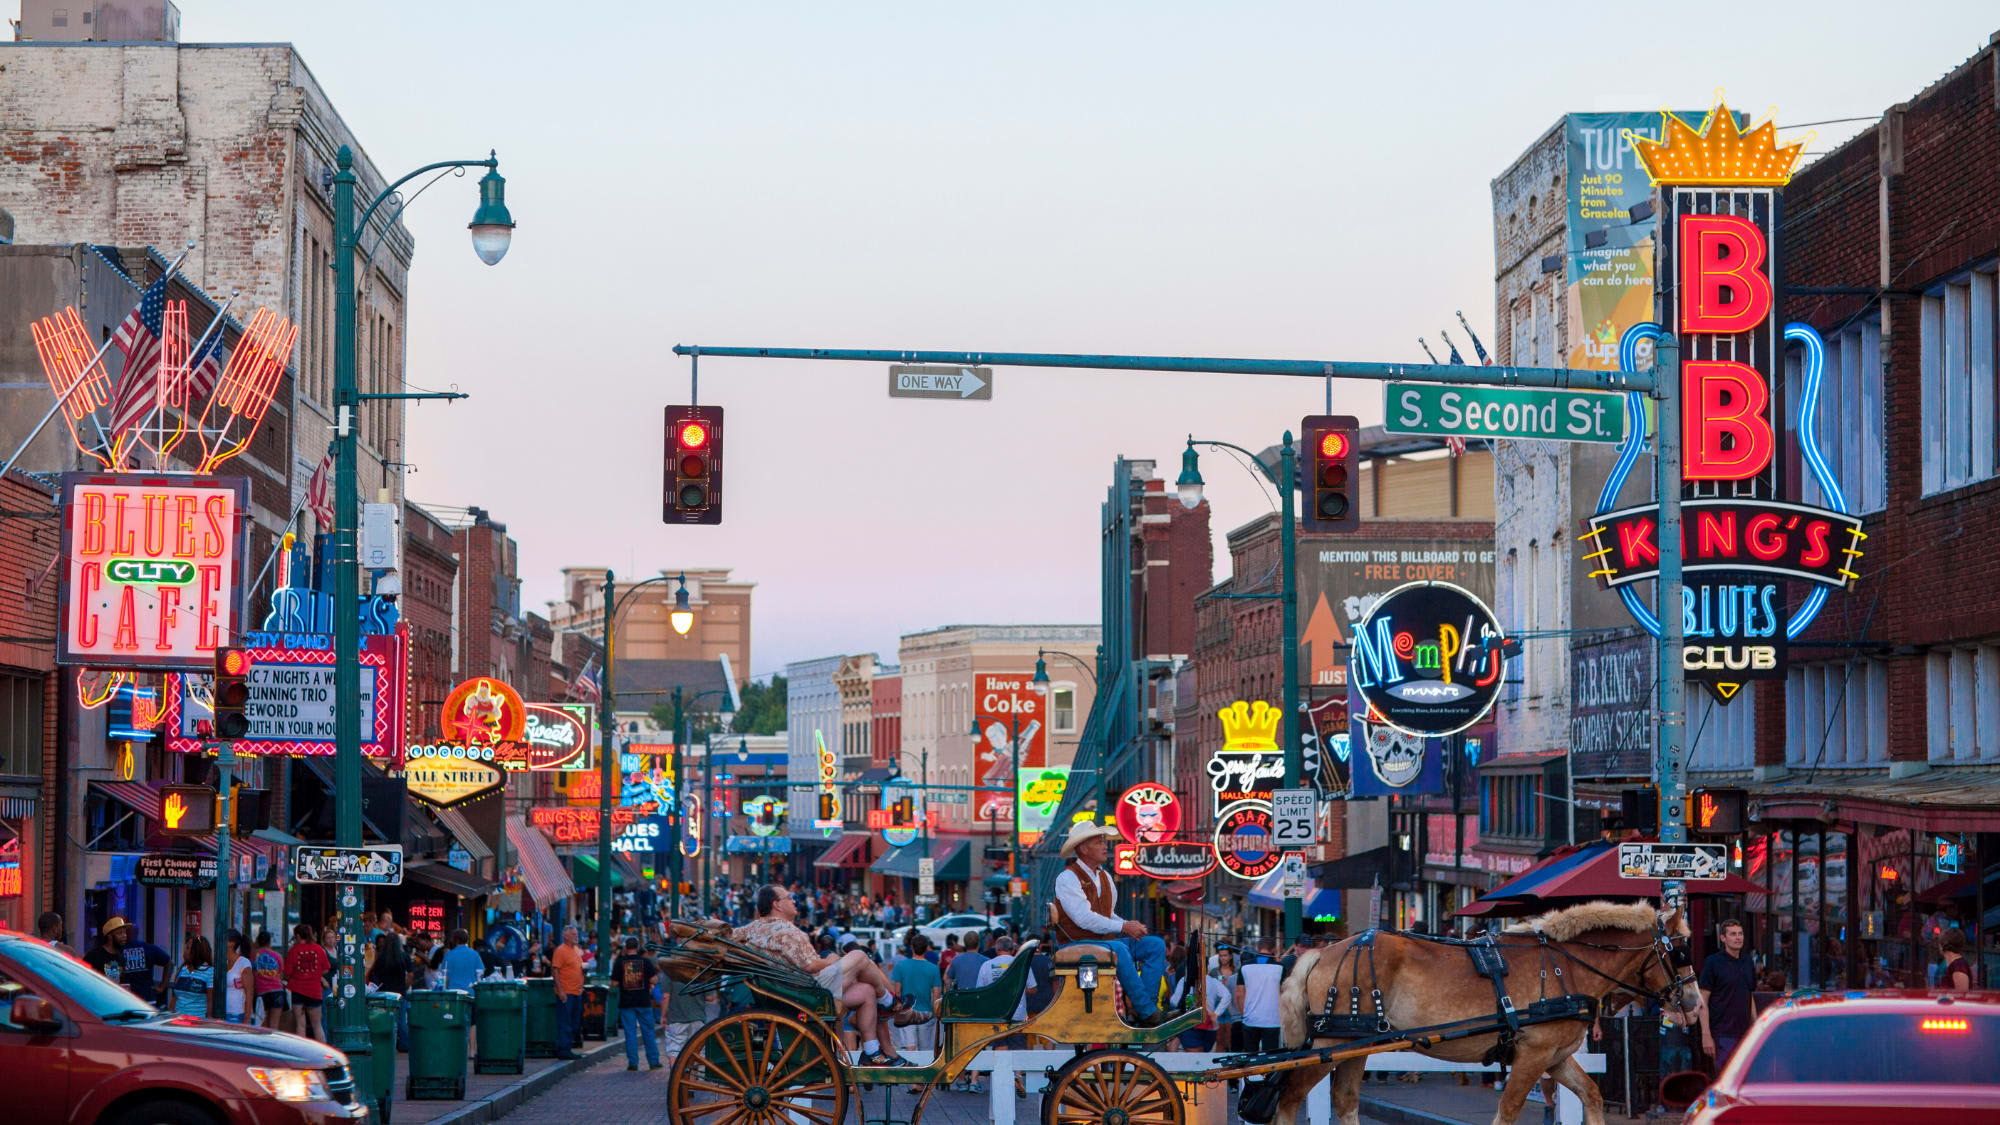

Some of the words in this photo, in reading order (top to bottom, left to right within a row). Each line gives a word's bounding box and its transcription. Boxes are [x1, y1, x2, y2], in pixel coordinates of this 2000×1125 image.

[1580, 127, 1657, 170] TUPE
[1580, 174, 1602, 185] Just
[1605, 174, 1623, 185] 90
[1580, 186, 1624, 196] Minutes
[1580, 197, 1606, 208] from
[1582, 247, 1631, 260] imagine
[1583, 261, 1612, 272] what
[1615, 263, 1637, 275] you
[1680, 214, 1773, 334] B
[1583, 277, 1608, 286] can
[1610, 275, 1623, 286] do
[1625, 275, 1652, 286] here
[1582, 334, 1651, 366] tupo
[901, 375, 929, 389] ONE
[934, 376, 963, 390] WAY
[1399, 390, 1429, 428] S.
[1438, 391, 1557, 434] Second
[1565, 398, 1612, 437] St.
[1681, 359, 1774, 481] B
[80, 492, 227, 559] BLUES
[1616, 511, 1832, 569] KNG'S
[1319, 551, 1369, 563] MENTION
[1372, 551, 1398, 563] THIS
[1401, 551, 1459, 563] BILLBOARD
[1463, 551, 1477, 563] TO
[113, 561, 191, 581] CITY
[1365, 565, 1401, 579] FREE
[1405, 565, 1456, 580] COVER
[78, 561, 220, 650] CAFE
[1682, 584, 1777, 638] BLUES
[245, 632, 280, 648] CITY
[284, 633, 330, 650] BAND
[1683, 645, 1777, 671] CLUB
[263, 670, 269, 684] 7
[272, 670, 311, 686] NIGHTS
[313, 671, 321, 685] A
[986, 677, 1020, 691] Have
[1025, 680, 1035, 691] a
[301, 688, 327, 702] TRIO
[983, 694, 1036, 714] Coke
[274, 722, 284, 735] IN
[288, 721, 314, 735] YOUR
[1571, 712, 1614, 754] COMPANY
[1616, 709, 1651, 752] STORE
[399, 771, 436, 783] EALE
[443, 771, 495, 783] STREET
[1125, 787, 1173, 807] PIG
[1220, 791, 1241, 800] HALL
[1244, 791, 1257, 800] OF
[1275, 796, 1312, 806] SPEED
[532, 810, 577, 824] KING'S
[579, 809, 634, 824] PACE
[1234, 810, 1267, 826] BAR
[1280, 807, 1308, 817] LIMIT
[622, 823, 660, 837] UES
[1277, 819, 1312, 839] 25
[1219, 834, 1281, 852] RESTAURA
[141, 858, 163, 867] First
[164, 858, 198, 869] Chance
[200, 860, 218, 869] RIBS
[144, 867, 159, 877] For
[160, 868, 166, 877] A
[168, 868, 194, 878] Drink
